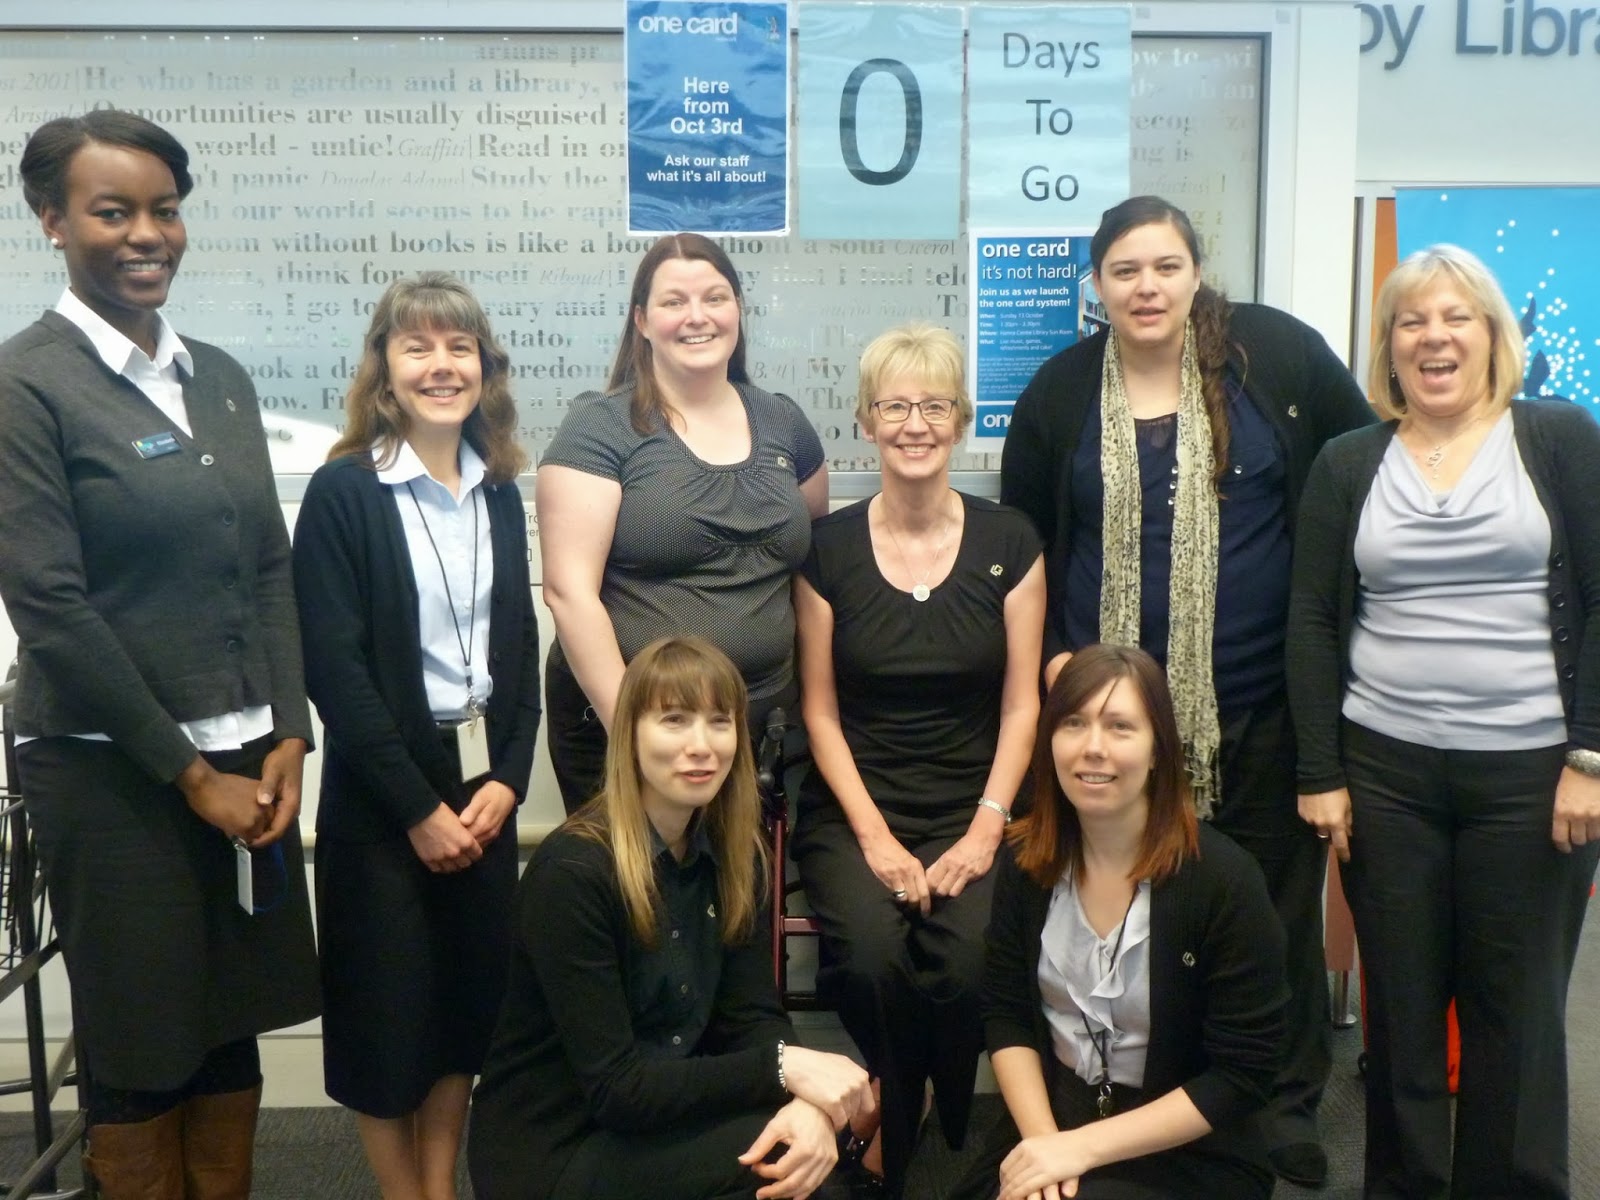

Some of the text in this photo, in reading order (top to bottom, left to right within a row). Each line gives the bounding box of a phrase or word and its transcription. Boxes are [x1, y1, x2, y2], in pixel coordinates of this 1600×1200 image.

[638, 12, 738, 35] one card
[1002, 31, 1101, 78] Days
[84, 66, 126, 92] He
[137, 66, 195, 92] who
[290, 67, 392, 97] garden
[404, 68, 456, 92] and
[468, 77, 484, 92] a
[495, 68, 600, 99] library,
[684, 77, 730, 94] Here
[307, 108, 352, 124] are
[365, 102, 464, 130] usually
[476, 102, 607, 130] disguised
[683, 97, 730, 114] from
[670, 117, 743, 135] Oct 3rd
[838, 57, 923, 186] 0
[1025, 99, 1073, 136] To
[195, 133, 277, 156] world
[311, 134, 393, 156] untie!
[479, 133, 551, 158] Read
[562, 135, 587, 158] in
[664, 155, 750, 167] Ask our staff
[471, 166, 552, 195] Study
[564, 165, 608, 190] the
[647, 170, 767, 183] what it's all about!
[1021, 165, 1079, 202] Go
[232, 205, 282, 221] our
[294, 200, 375, 220] world
[385, 206, 473, 221] seems
[272, 231, 378, 253] without
[391, 231, 475, 253] books
[487, 232, 508, 253] is
[518, 231, 570, 253] like
[580, 238, 596, 253] a
[982, 238, 1070, 259] one card
[1007, 267, 1033, 280] not
[1037, 263, 1077, 279] hard!
[979, 286, 1069, 297] Join us as we launch
[285, 293, 295, 316] I
[979, 300, 994, 308] the
[1015, 299, 1034, 307] card
[1036, 298, 1070, 308] system!
[305, 364, 319, 378] a
[806, 357, 846, 385] My
